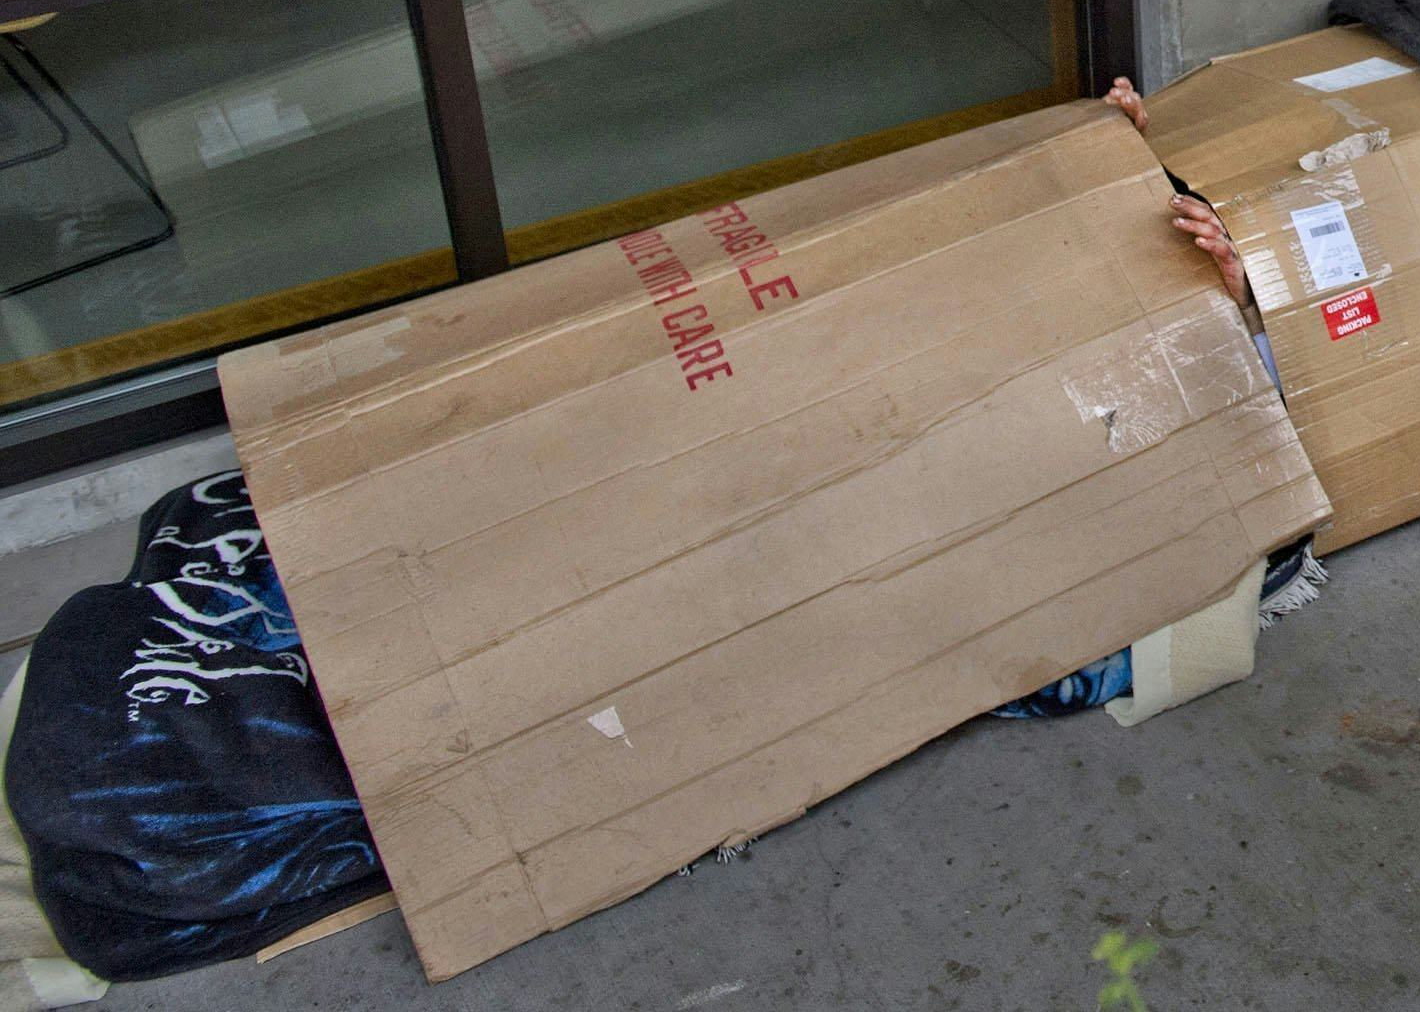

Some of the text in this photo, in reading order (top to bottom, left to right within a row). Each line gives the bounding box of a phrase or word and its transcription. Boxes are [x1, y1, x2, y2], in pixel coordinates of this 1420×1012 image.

[695, 201, 799, 311] FRAGILE
[637, 255, 697, 307] WITH
[1326, 290, 1368, 314] ENCLOSED
[1342, 306, 1361, 321] LIST
[1336, 314, 1372, 336] PACKING
[661, 304, 733, 392] CARE
